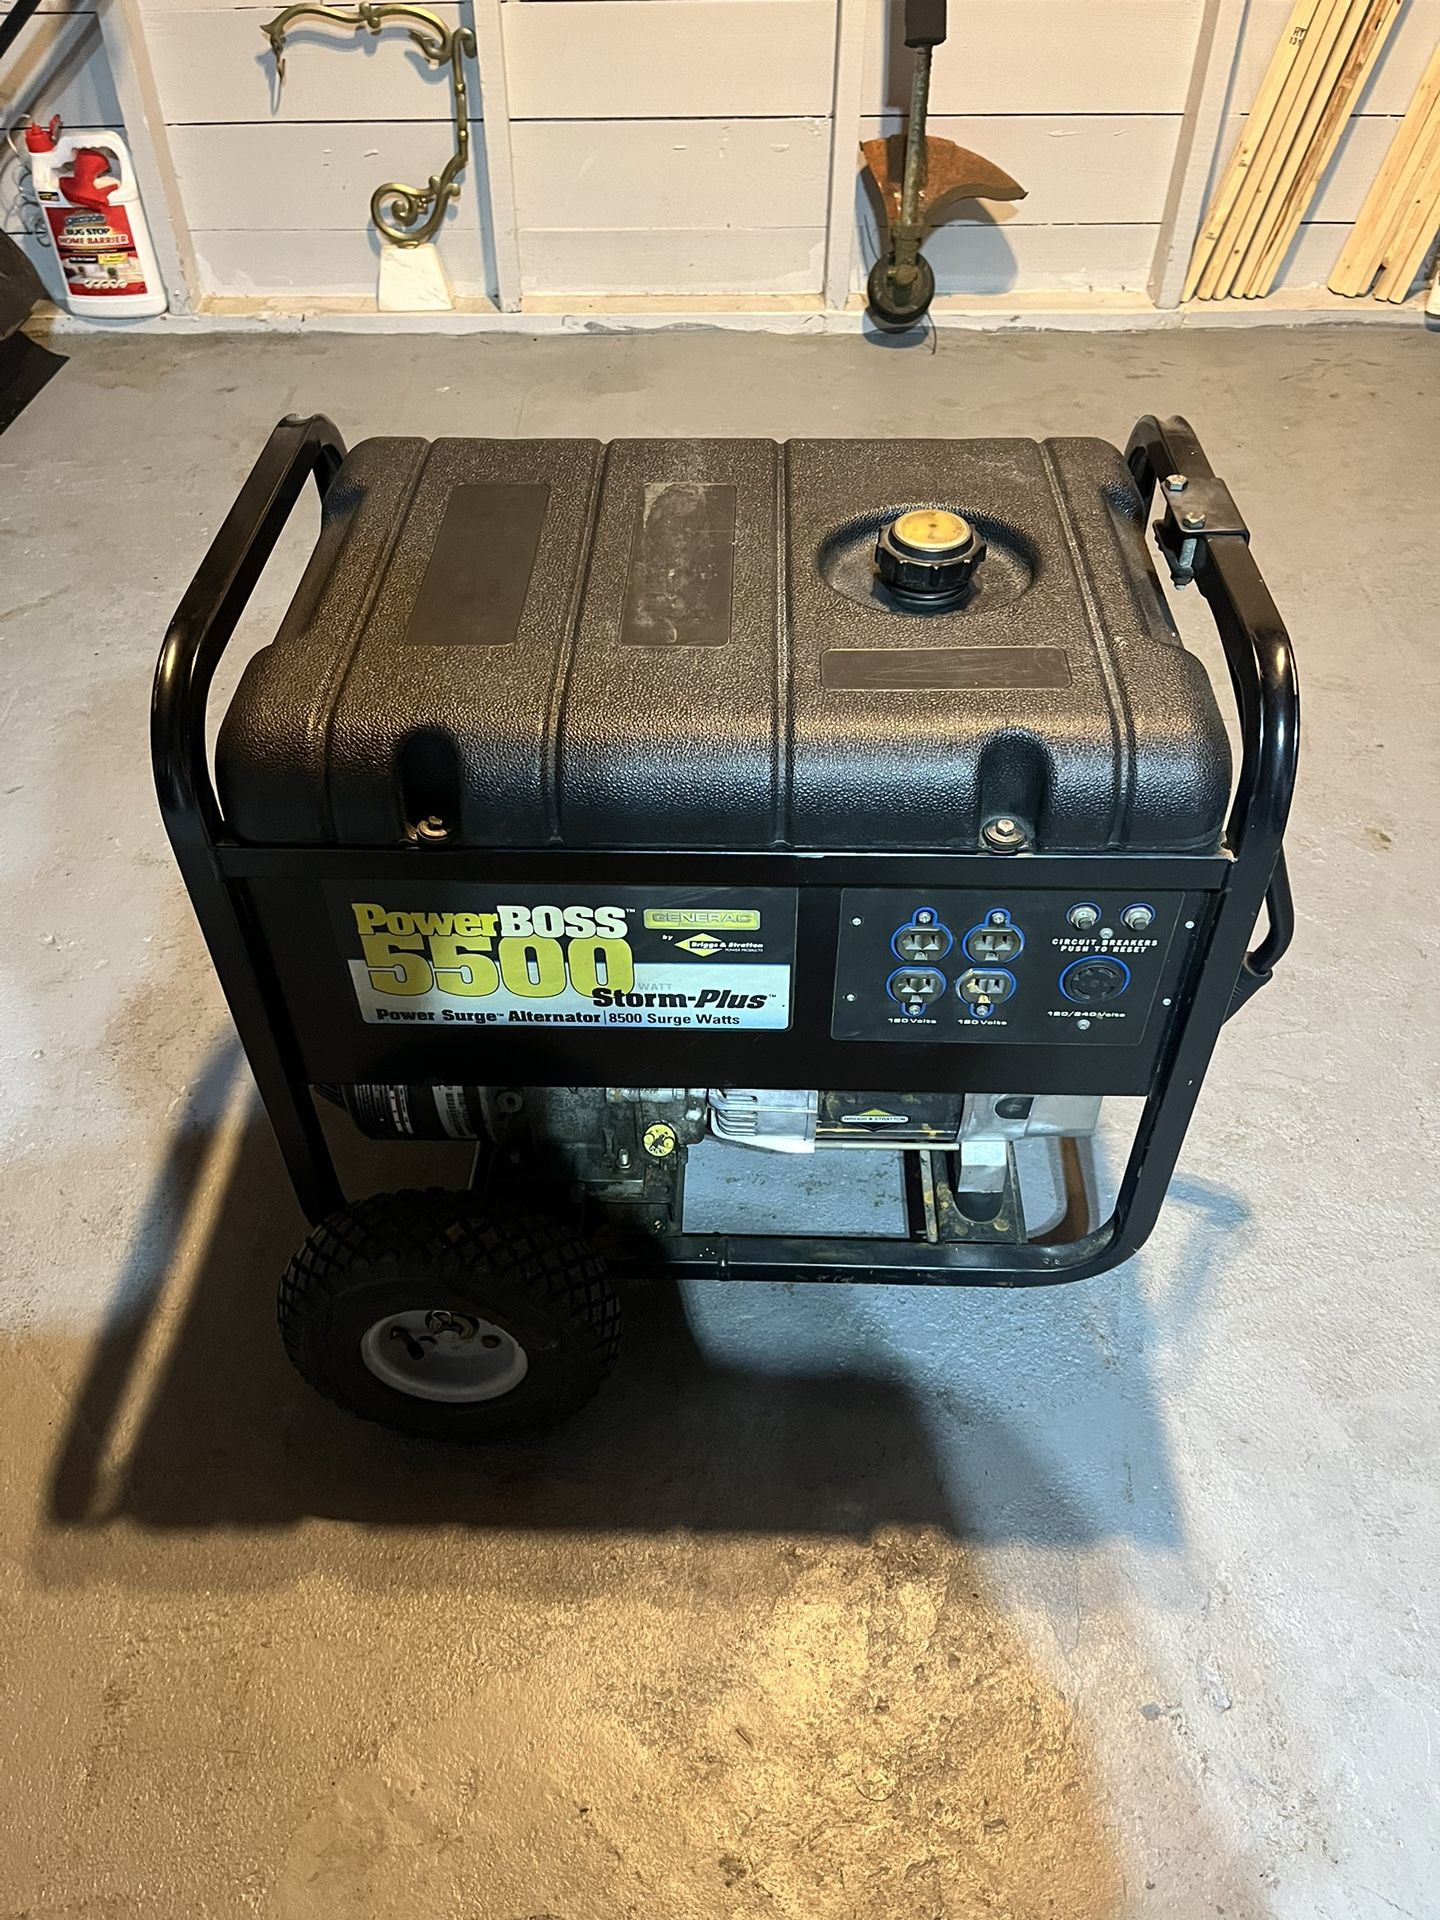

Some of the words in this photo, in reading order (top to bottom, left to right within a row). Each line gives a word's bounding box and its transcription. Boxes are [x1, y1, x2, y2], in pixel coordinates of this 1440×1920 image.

[66, 228, 85, 236] BUG
[86, 227, 111, 235] STOP
[58, 236, 84, 245] HOME
[87, 235, 128, 244] BARRIER
[652, 912, 753, 923] GENERAC
[1052, 938, 1097, 946] CIRCUIT
[1101, 939, 1159, 947] BREAKERS
[360, 933, 635, 998] 5500
[638, 983, 673, 991] WATT
[376, 1008, 435, 1020] Power
[508, 1010, 600, 1023] Alternator
[609, 1013, 643, 1023] 8500
[647, 1013, 691, 1026] Surge
[696, 1014, 740, 1024] Watts
